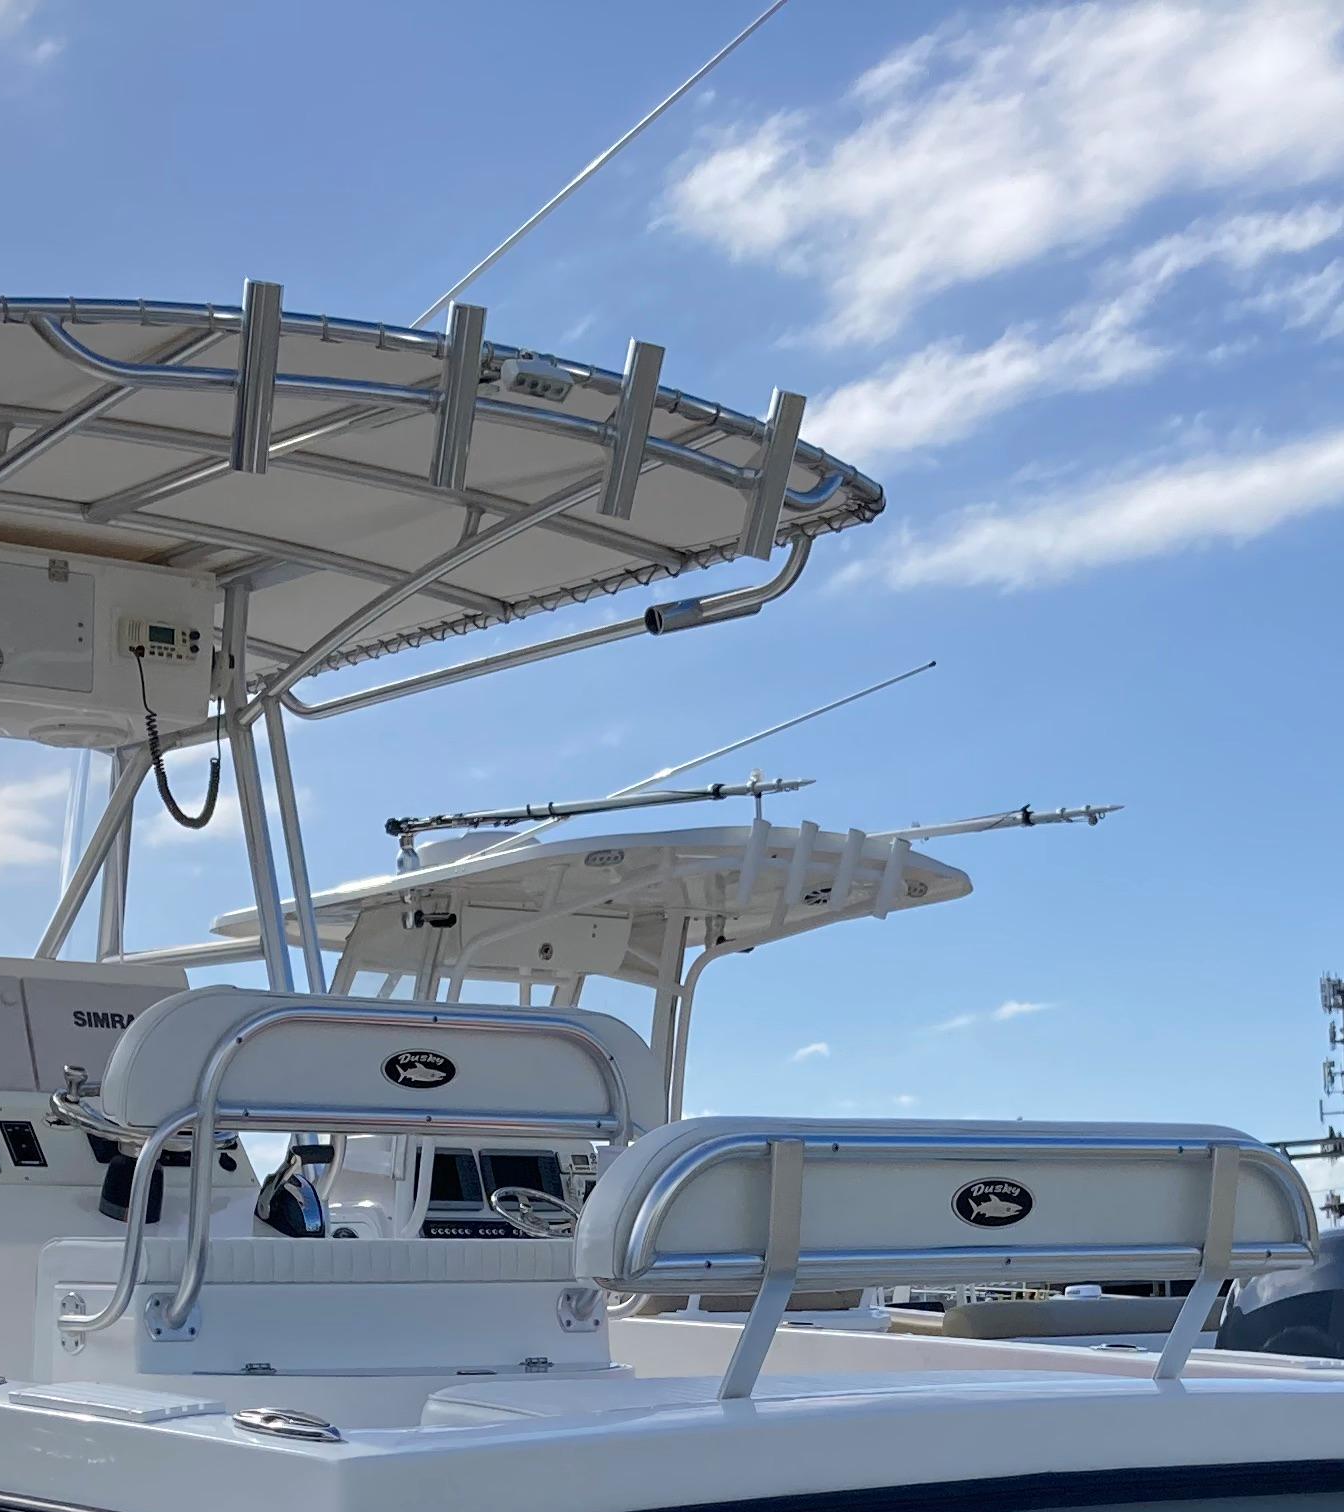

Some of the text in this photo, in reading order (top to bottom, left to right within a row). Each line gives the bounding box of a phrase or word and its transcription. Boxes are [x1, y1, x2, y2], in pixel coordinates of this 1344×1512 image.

[72, 1010, 136, 1030] SIMR
[398, 1053, 445, 1066] Dusky
[970, 1183, 1021, 1197] Dusky
